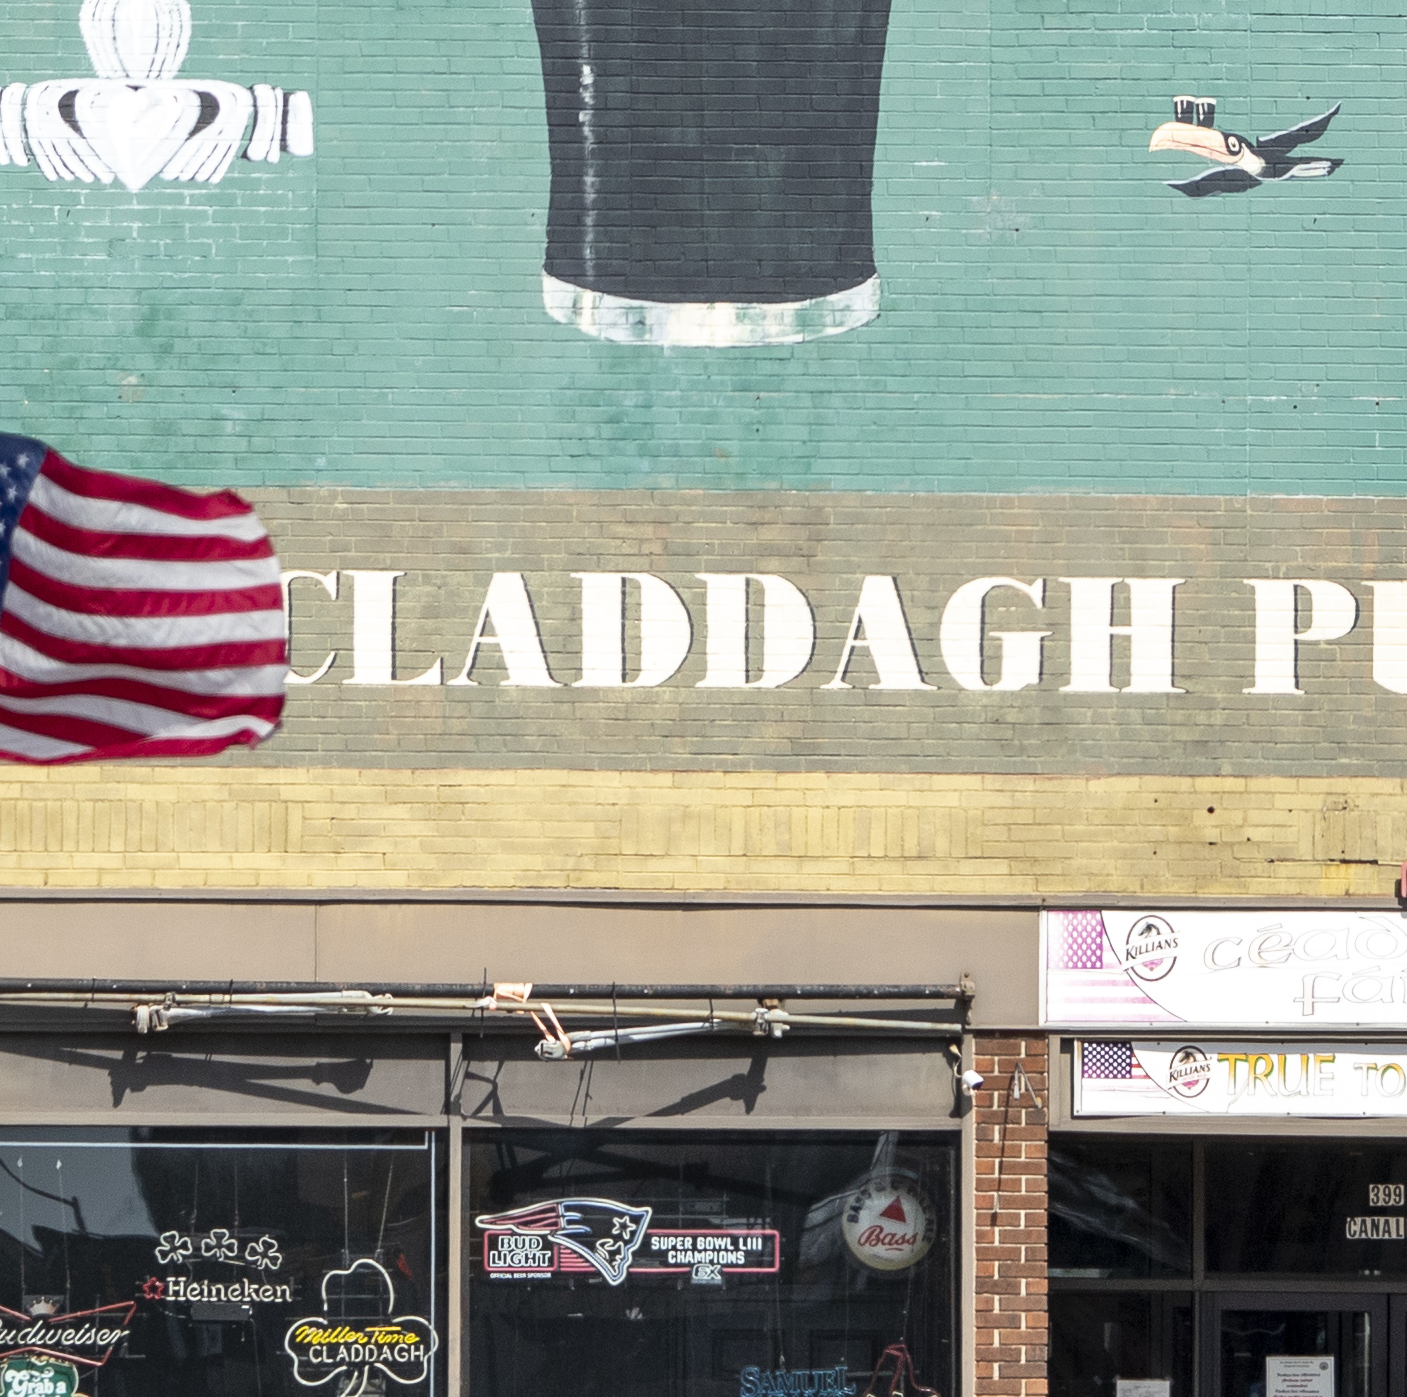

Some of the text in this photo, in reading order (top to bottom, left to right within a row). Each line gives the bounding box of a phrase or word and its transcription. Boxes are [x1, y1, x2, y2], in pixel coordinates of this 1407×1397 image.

[1217, 1052, 1336, 1097] TRUE
[1353, 1062, 1407, 1097] TO
[1370, 1185, 1402, 1205] 399
[858, 1225, 918, 1248] Bass
[1347, 1218, 1403, 1238] CANAL
[498, 1235, 542, 1251] BUD
[651, 1236, 762, 1250] SUPER BOWL LIII
[490, 1250, 553, 1267] LIGHT
[668, 1250, 745, 1264] CHAMPIONS
[166, 1277, 292, 1302] Heineken
[295, 1325, 420, 1344] Miller Time
[309, 1344, 425, 1362] CLADDAGH
[5, 1368, 67, 1397] Grab a
[740, 1364, 856, 1394] SAMUEL
